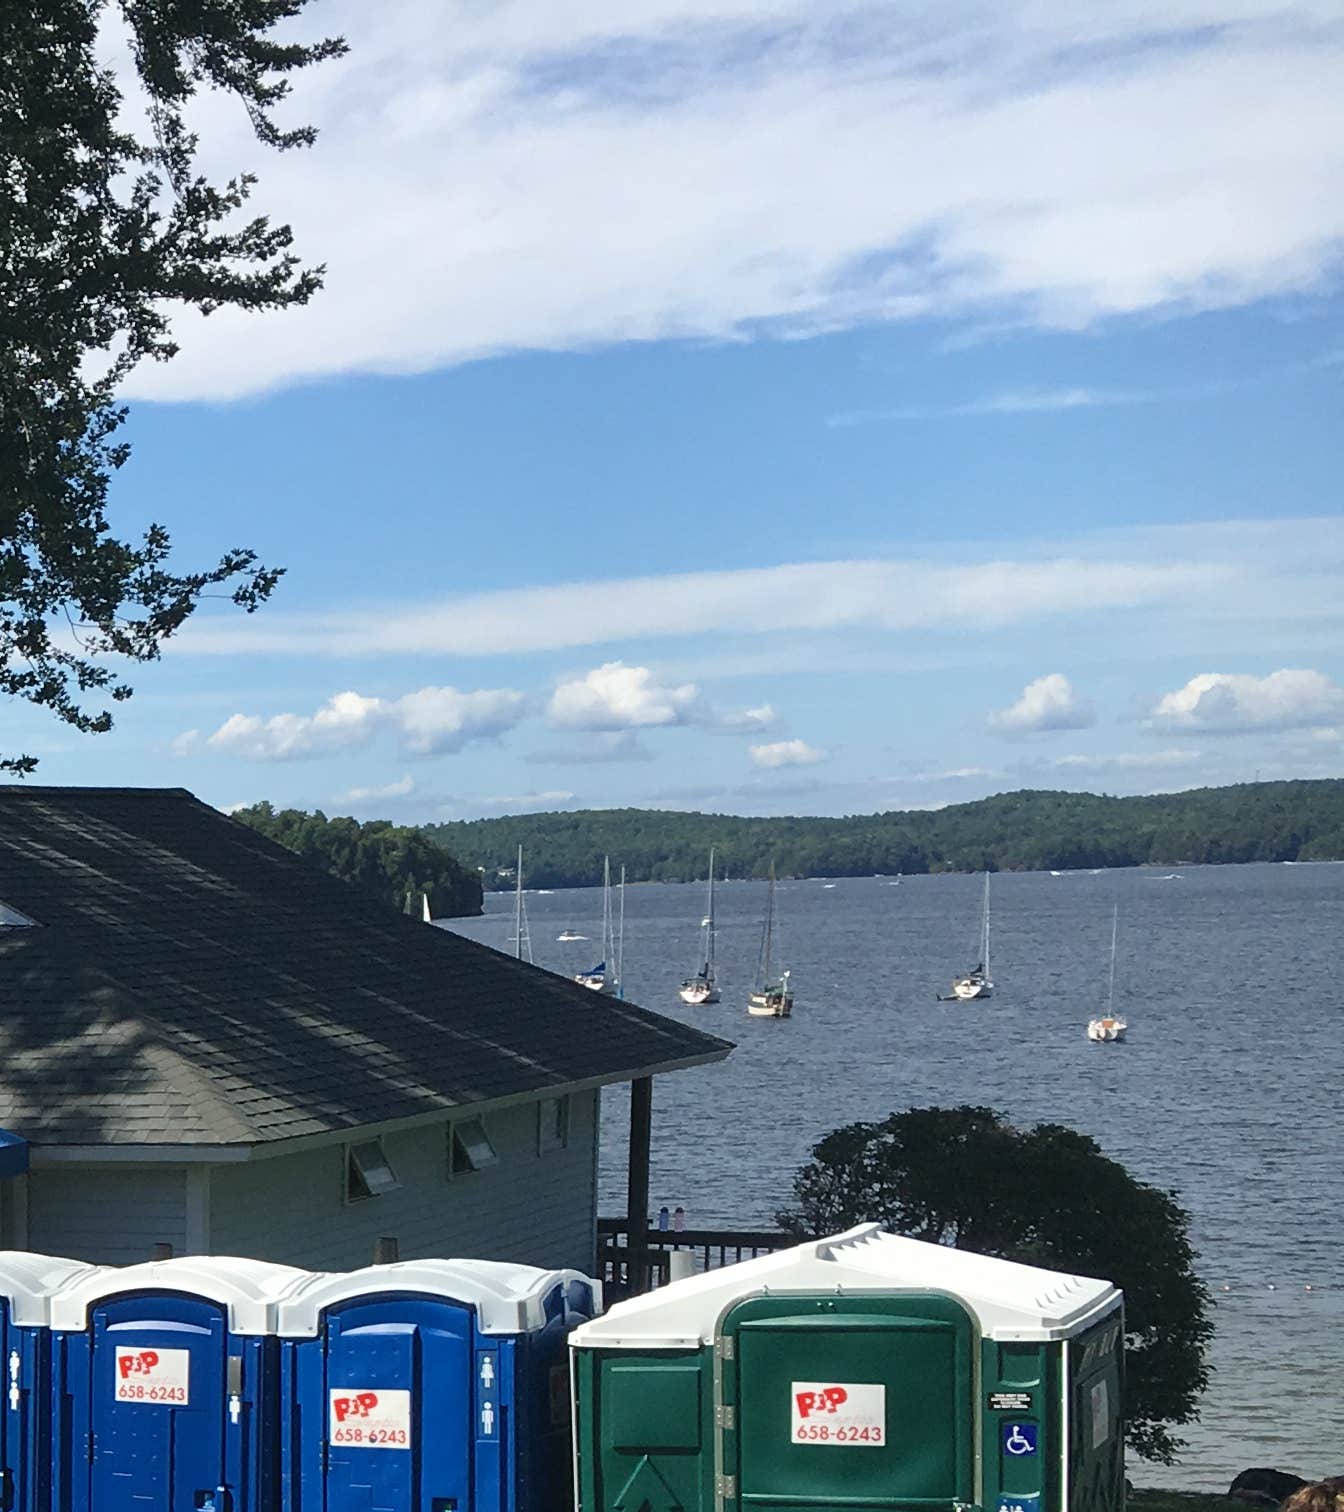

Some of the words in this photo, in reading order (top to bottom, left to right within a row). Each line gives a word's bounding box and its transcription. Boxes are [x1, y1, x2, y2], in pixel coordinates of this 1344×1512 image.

[118, 1384, 185, 1401] 658-6243
[335, 1428, 407, 1443] 658-6243
[797, 1425, 882, 1441] 658-6243
